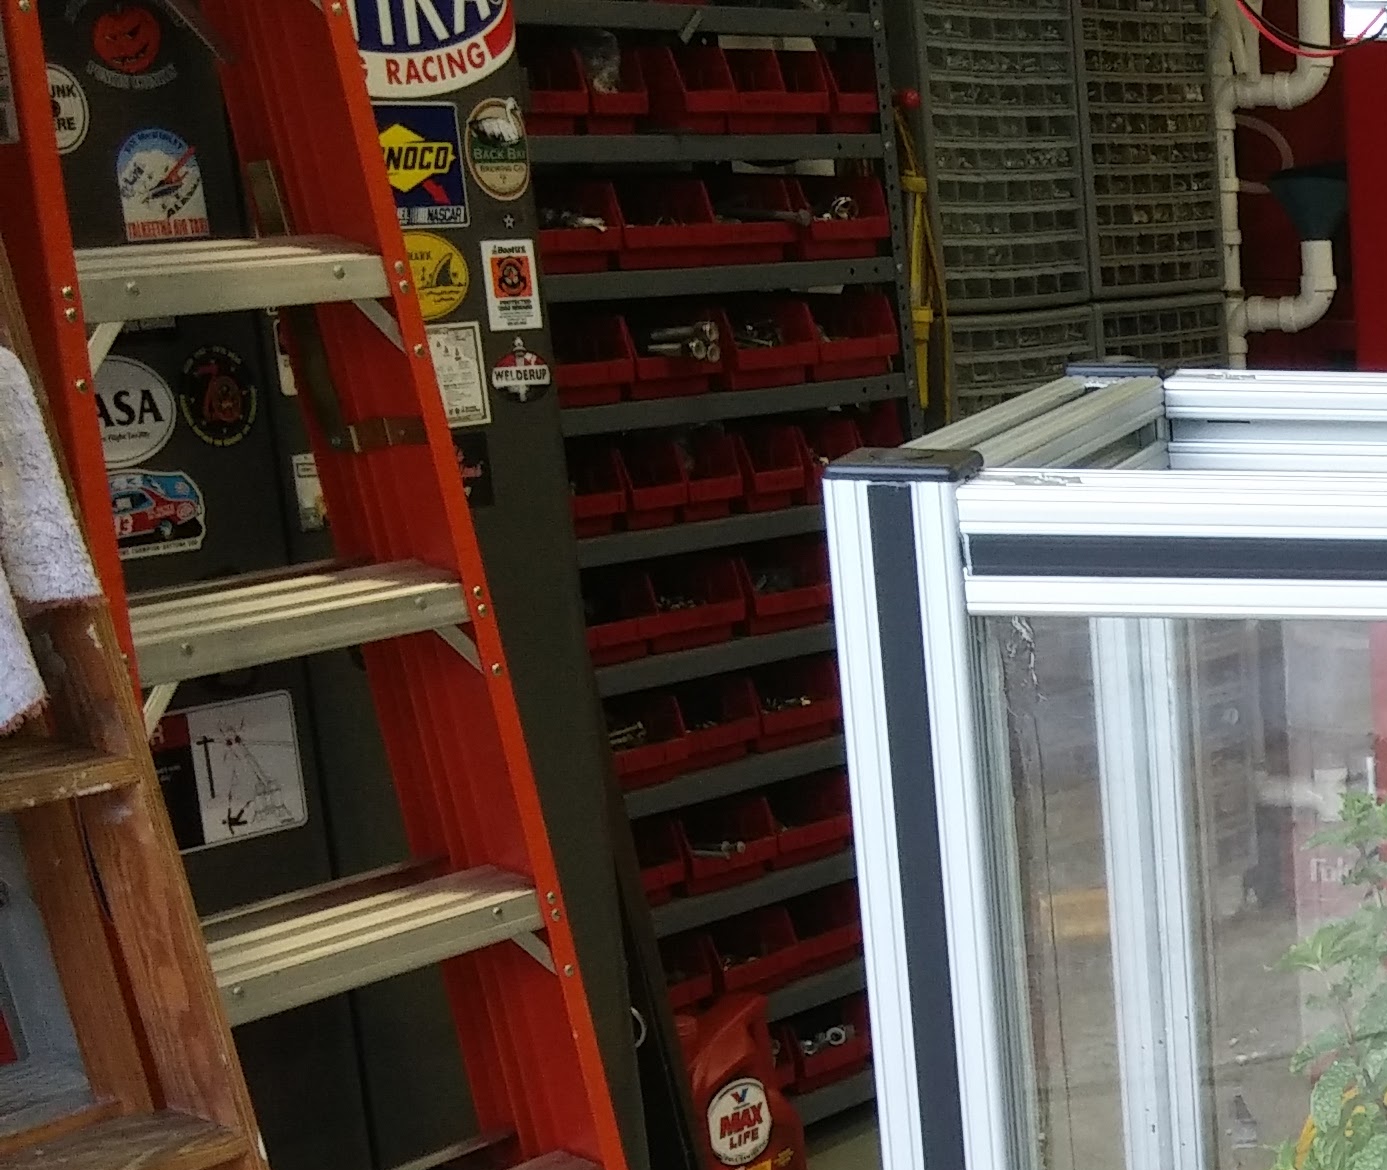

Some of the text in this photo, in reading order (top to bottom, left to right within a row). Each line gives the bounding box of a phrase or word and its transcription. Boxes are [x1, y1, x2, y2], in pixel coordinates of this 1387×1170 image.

[385, 42, 486, 85] RACING
[386, 146, 449, 171] NOCO
[473, 147, 505, 160] BACK
[427, 208, 463, 222] NASCAR
[494, 368, 547, 381] WELDERUP
[95, 387, 165, 428] ASA
[719, 1101, 764, 1140] MAX
[729, 1127, 760, 1151] LIFE
